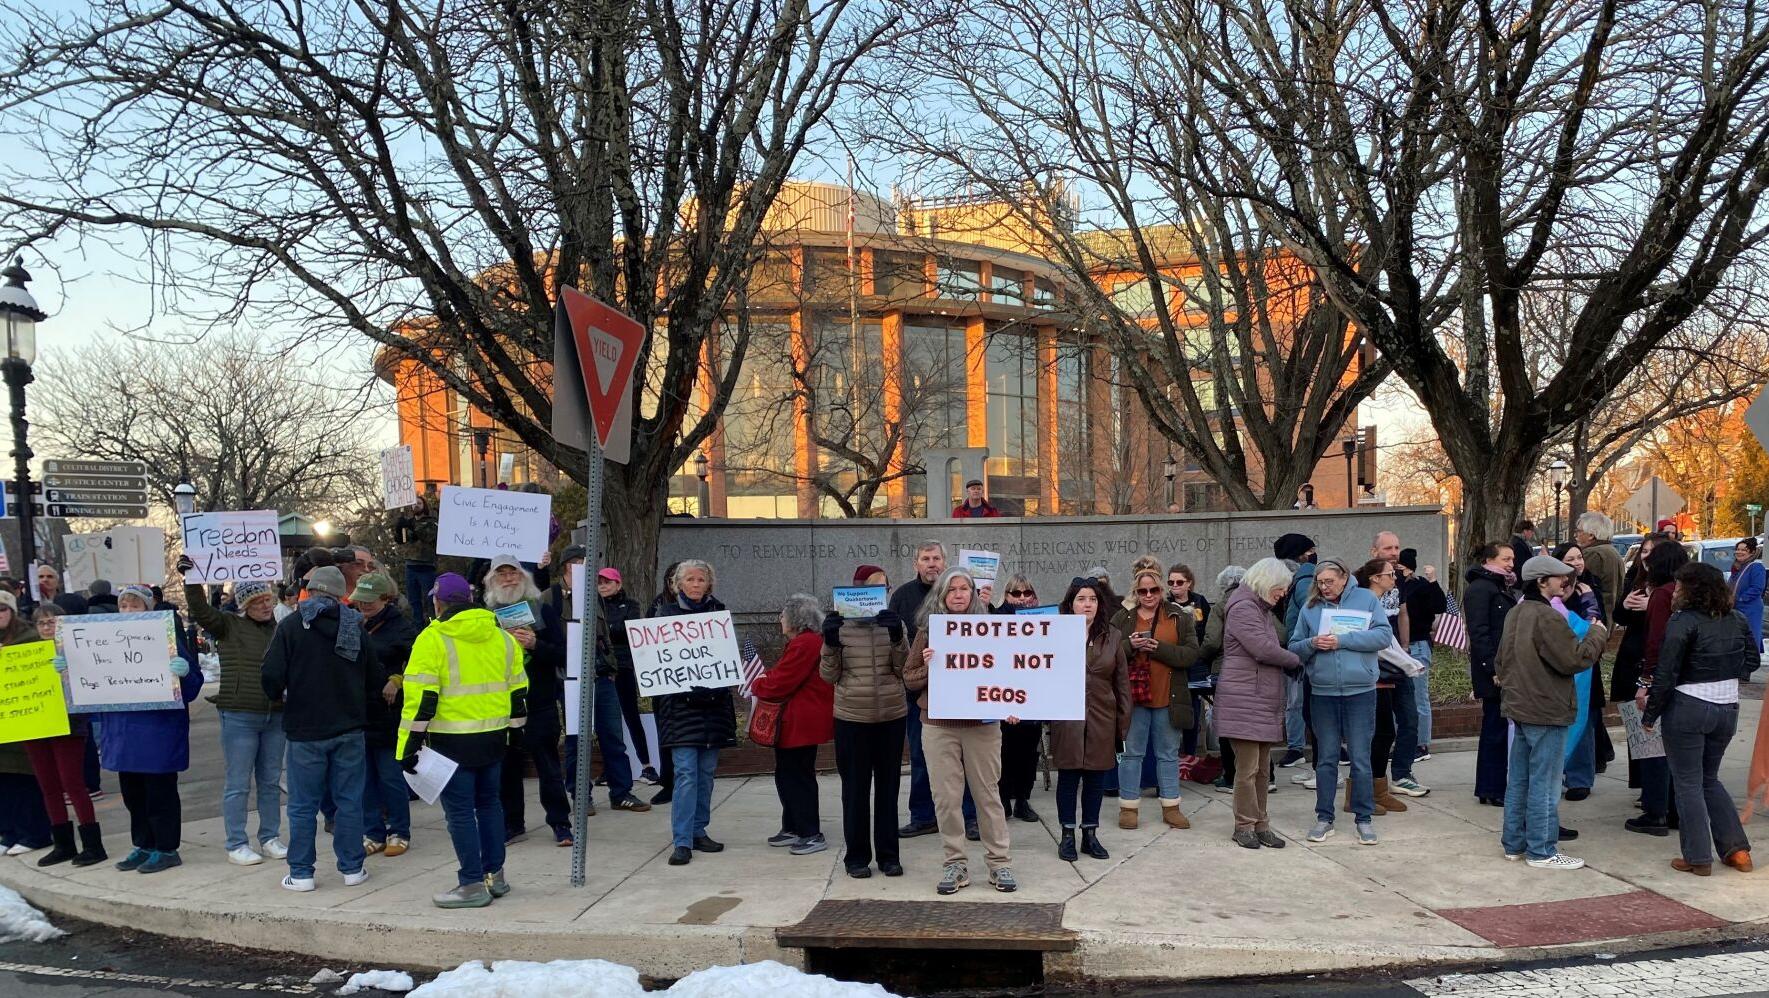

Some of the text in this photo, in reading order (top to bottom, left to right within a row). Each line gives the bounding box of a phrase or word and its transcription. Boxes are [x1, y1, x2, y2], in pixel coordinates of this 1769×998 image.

[593, 337, 617, 362] YIELD
[62, 464, 128, 473] CULTURAL DISTRICT
[64, 479, 129, 488] JUSTICE CENTER
[64, 492, 127, 501] TRAIN STATION
[453, 492, 539, 516] Civic Engagement
[65, 507, 95, 515] DINING
[103, 508, 129, 516] SHOPS
[469, 516, 477, 527] Is
[483, 519, 490, 528] A
[184, 514, 277, 548] Freedom
[453, 533, 525, 550] Not A Crime
[720, 544, 741, 559] TO
[752, 543, 836, 559] REMEMBER
[847, 543, 880, 558] AND
[1008, 541, 1095, 556] AMERICANS
[1104, 539, 1138, 554] WHO
[1150, 538, 1188, 553] GAVE
[1196, 537, 1215, 552] OF
[216, 545, 258, 560] Needs
[191, 553, 278, 582] Voices
[1001, 560, 1069, 575] VIETNAM
[628, 617, 730, 648] DIVERSITY
[946, 620, 1050, 637] PROTECT
[72, 628, 109, 648] Free
[93, 650, 143, 665] Has NO
[657, 645, 714, 664] IS OUR
[945, 653, 1054, 669] KIDS NOT
[80, 673, 164, 690] Age Restrictions!
[640, 660, 740, 688] STRENGTH
[977, 687, 1027, 704] EGOS
